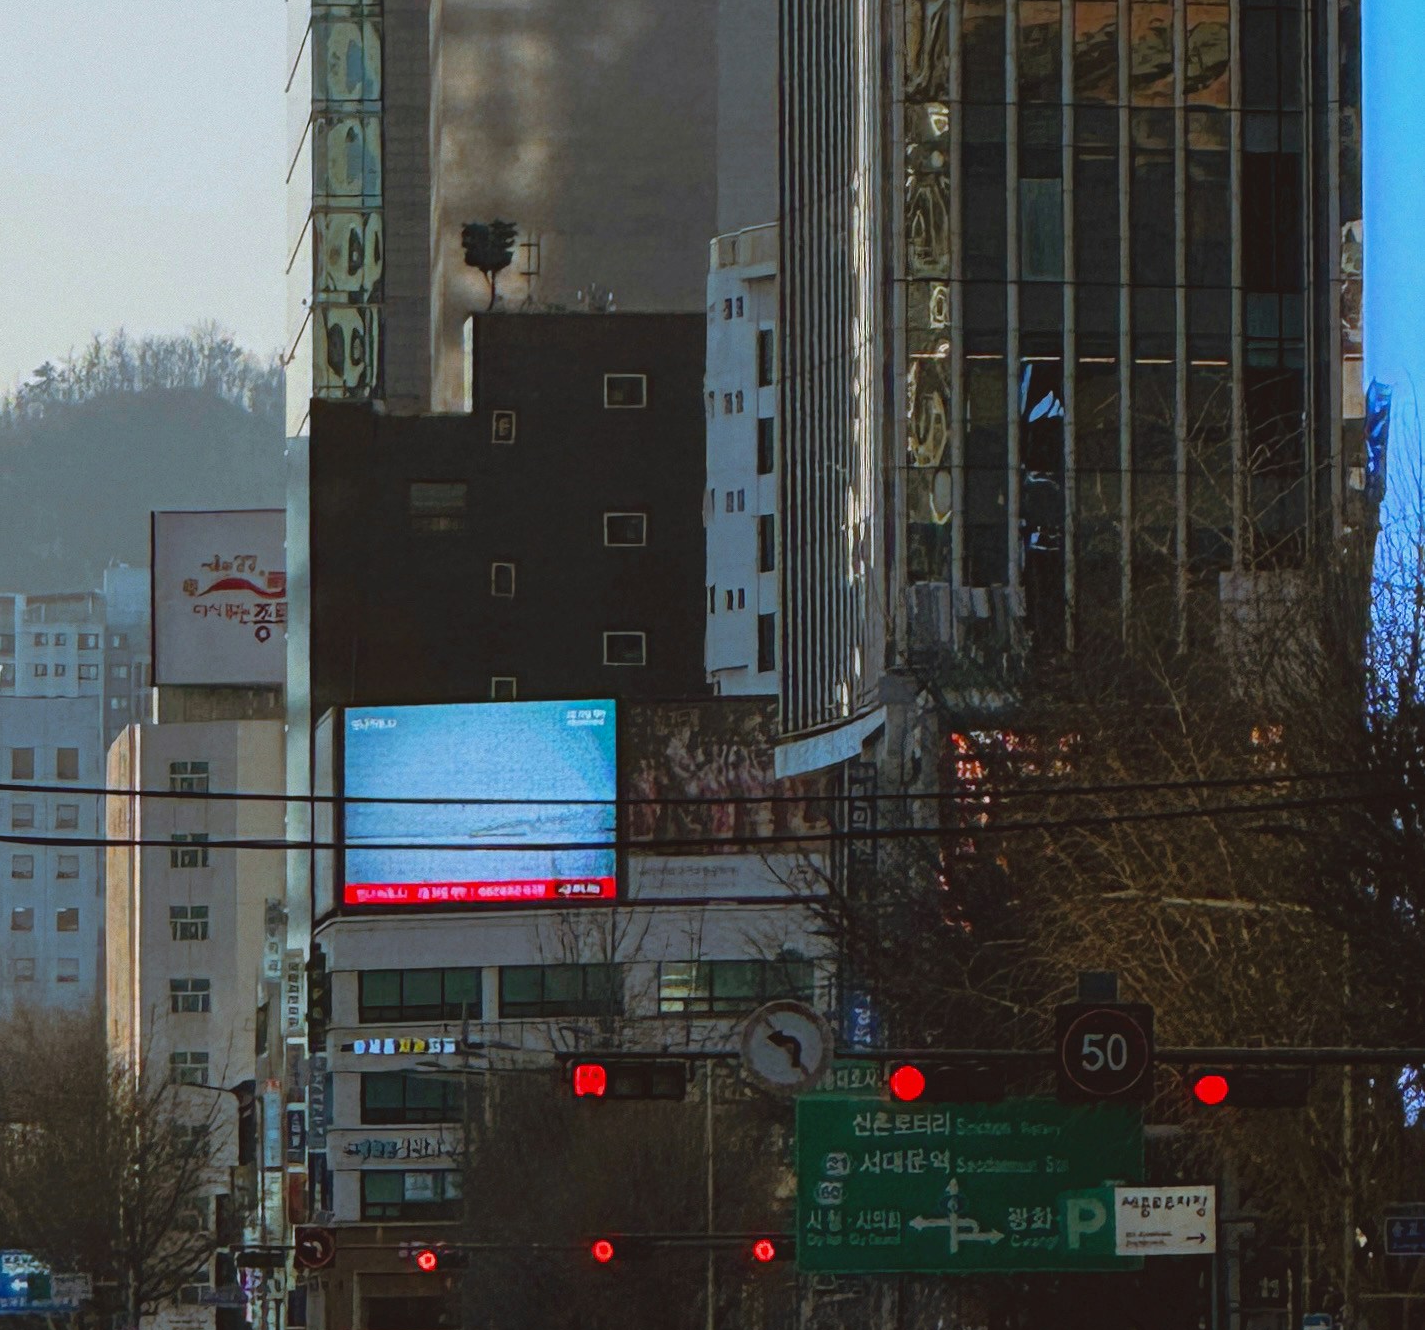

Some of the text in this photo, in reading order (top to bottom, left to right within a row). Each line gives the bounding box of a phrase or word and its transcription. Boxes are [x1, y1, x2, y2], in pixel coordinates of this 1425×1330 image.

[1081, 1033, 1128, 1071] 50
[853, 1112, 950, 1136] 신촌로터리
[859, 1148, 950, 1174] 서대문역
[1067, 1198, 1107, 1249] P
